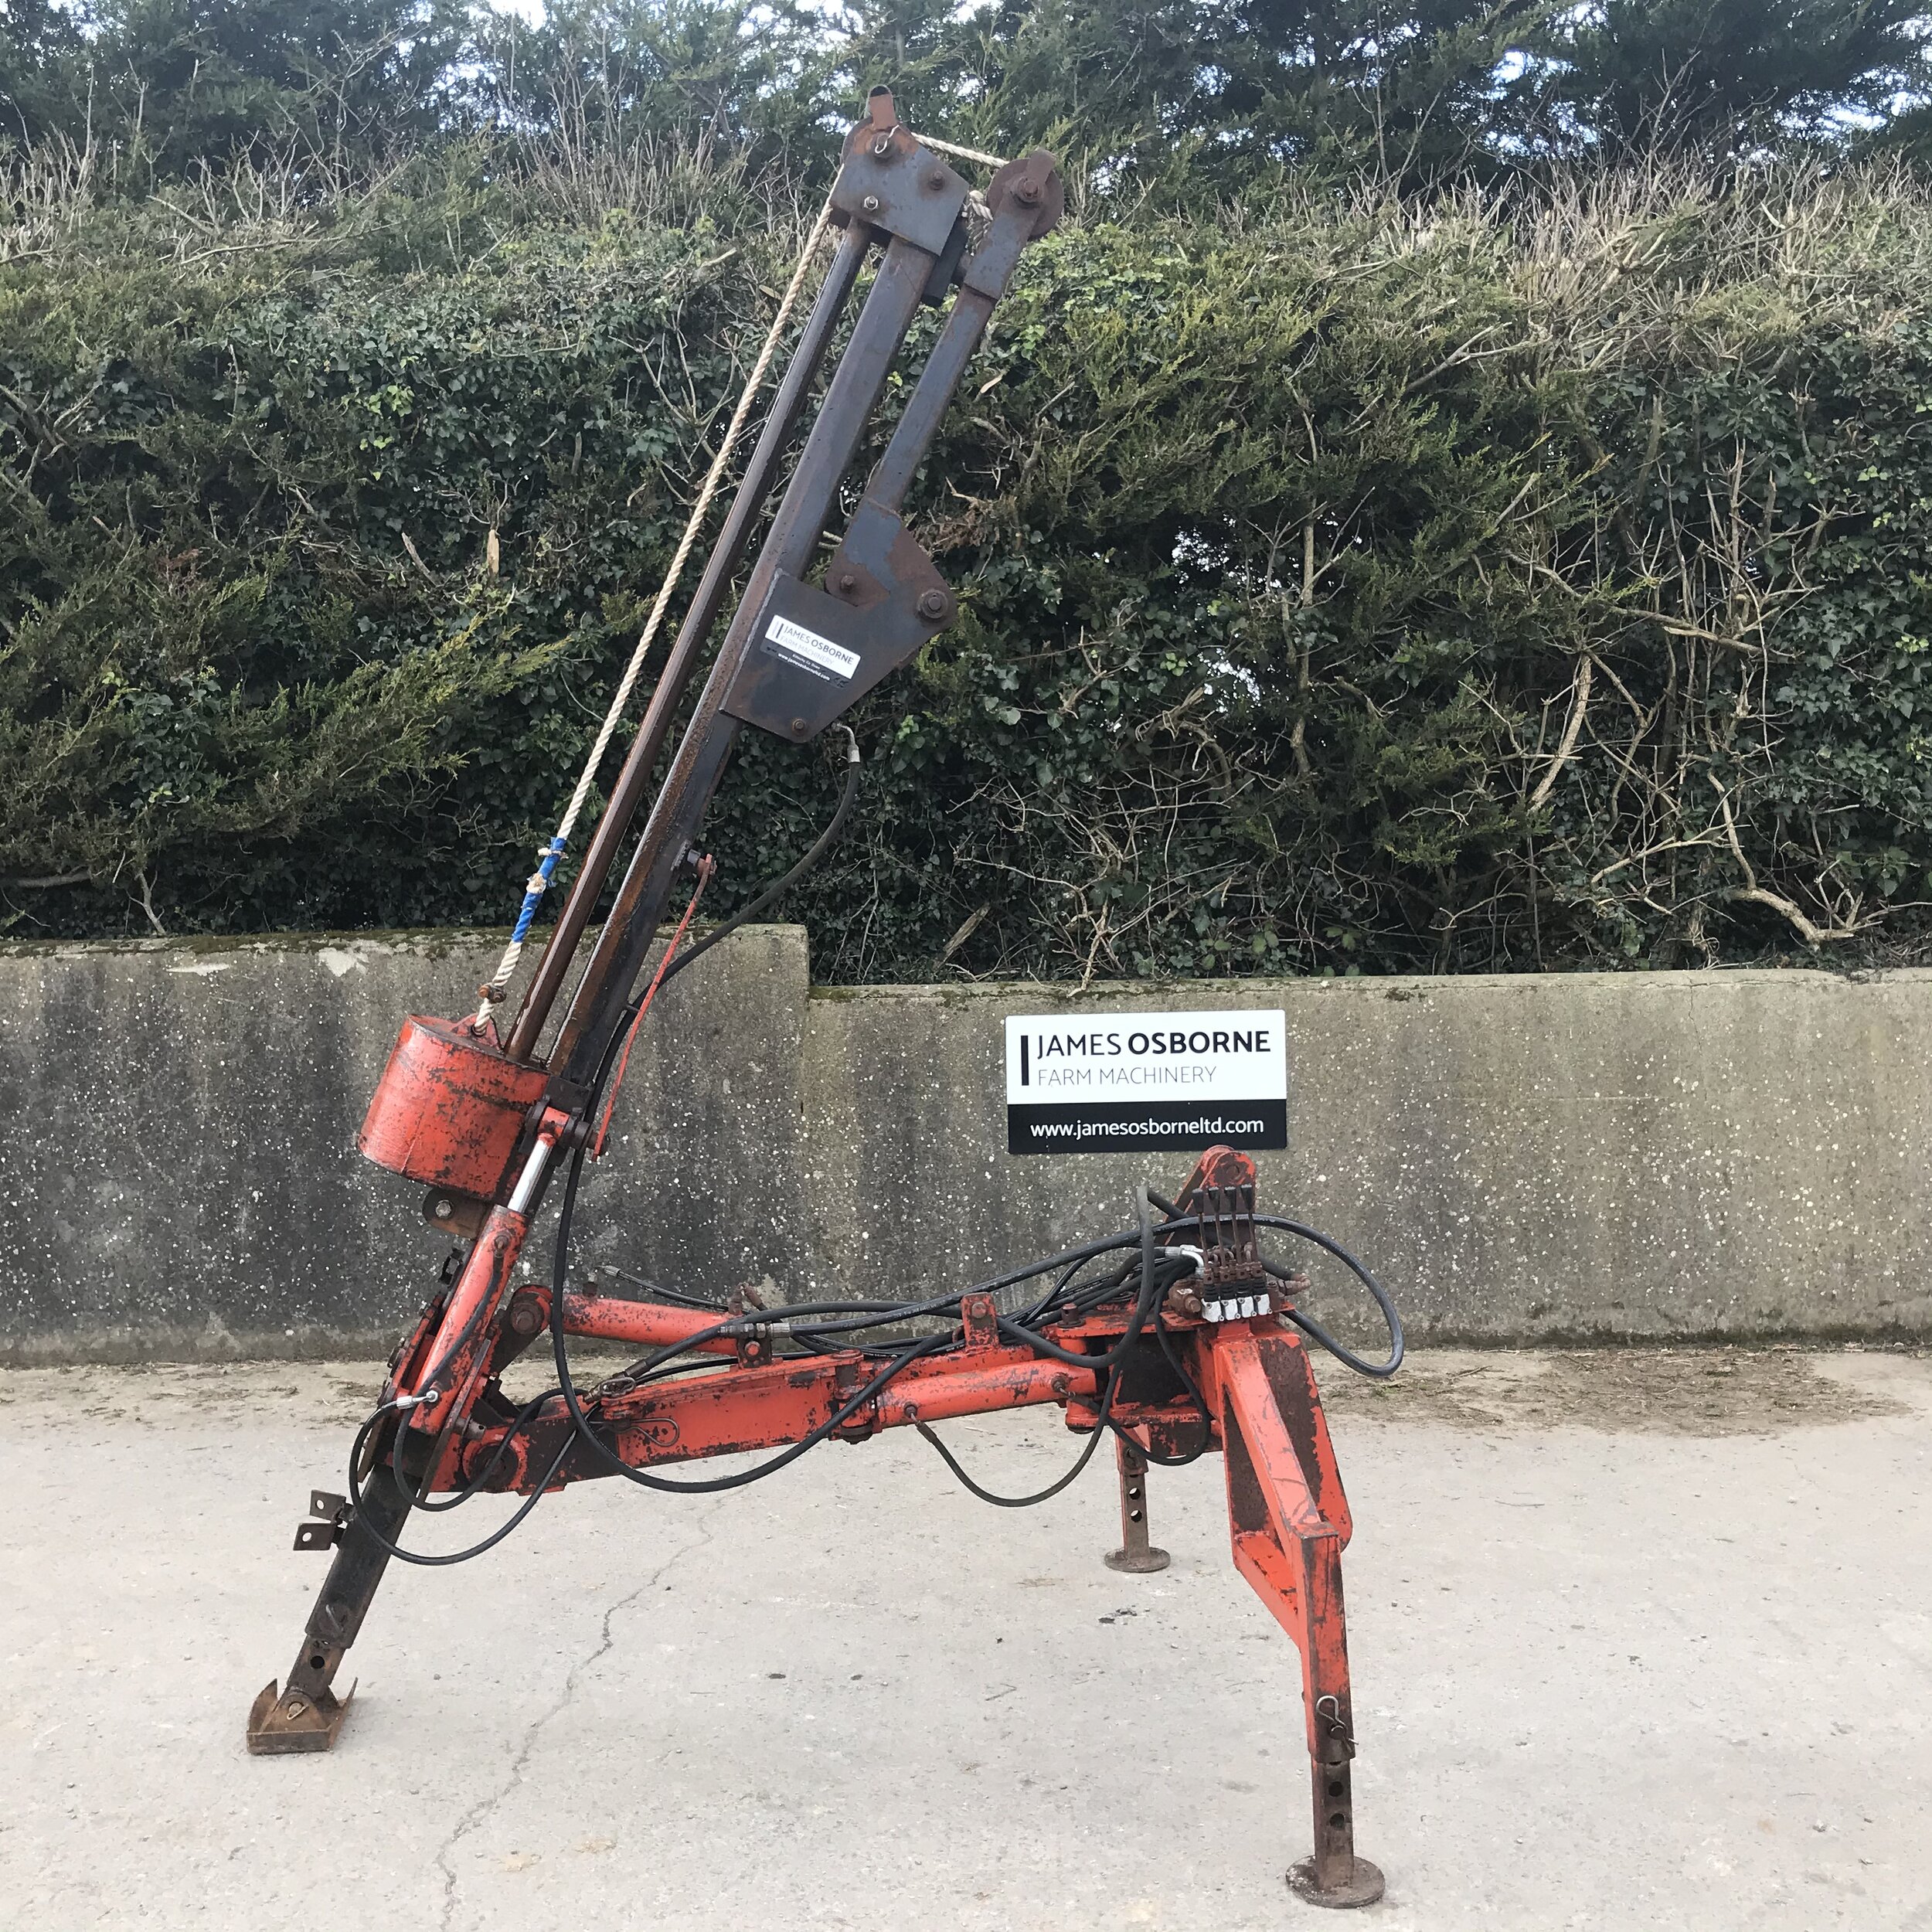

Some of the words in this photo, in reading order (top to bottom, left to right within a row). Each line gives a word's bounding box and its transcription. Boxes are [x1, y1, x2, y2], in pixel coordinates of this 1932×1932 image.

[780, 635, 798, 648] FARM
[798, 644, 835, 665] MACHINERY
[784, 625, 810, 644] JAMES
[811, 639, 854, 665] OSBORNE
[1036, 1033, 1121, 1060] JAMES
[1128, 1030, 1271, 1055] OSBORNE
[1038, 1068, 1092, 1087] FARM
[1099, 1066, 1217, 1085] MACHINERY
[1029, 1117, 1264, 1141] www.jamesosborneltd.com
